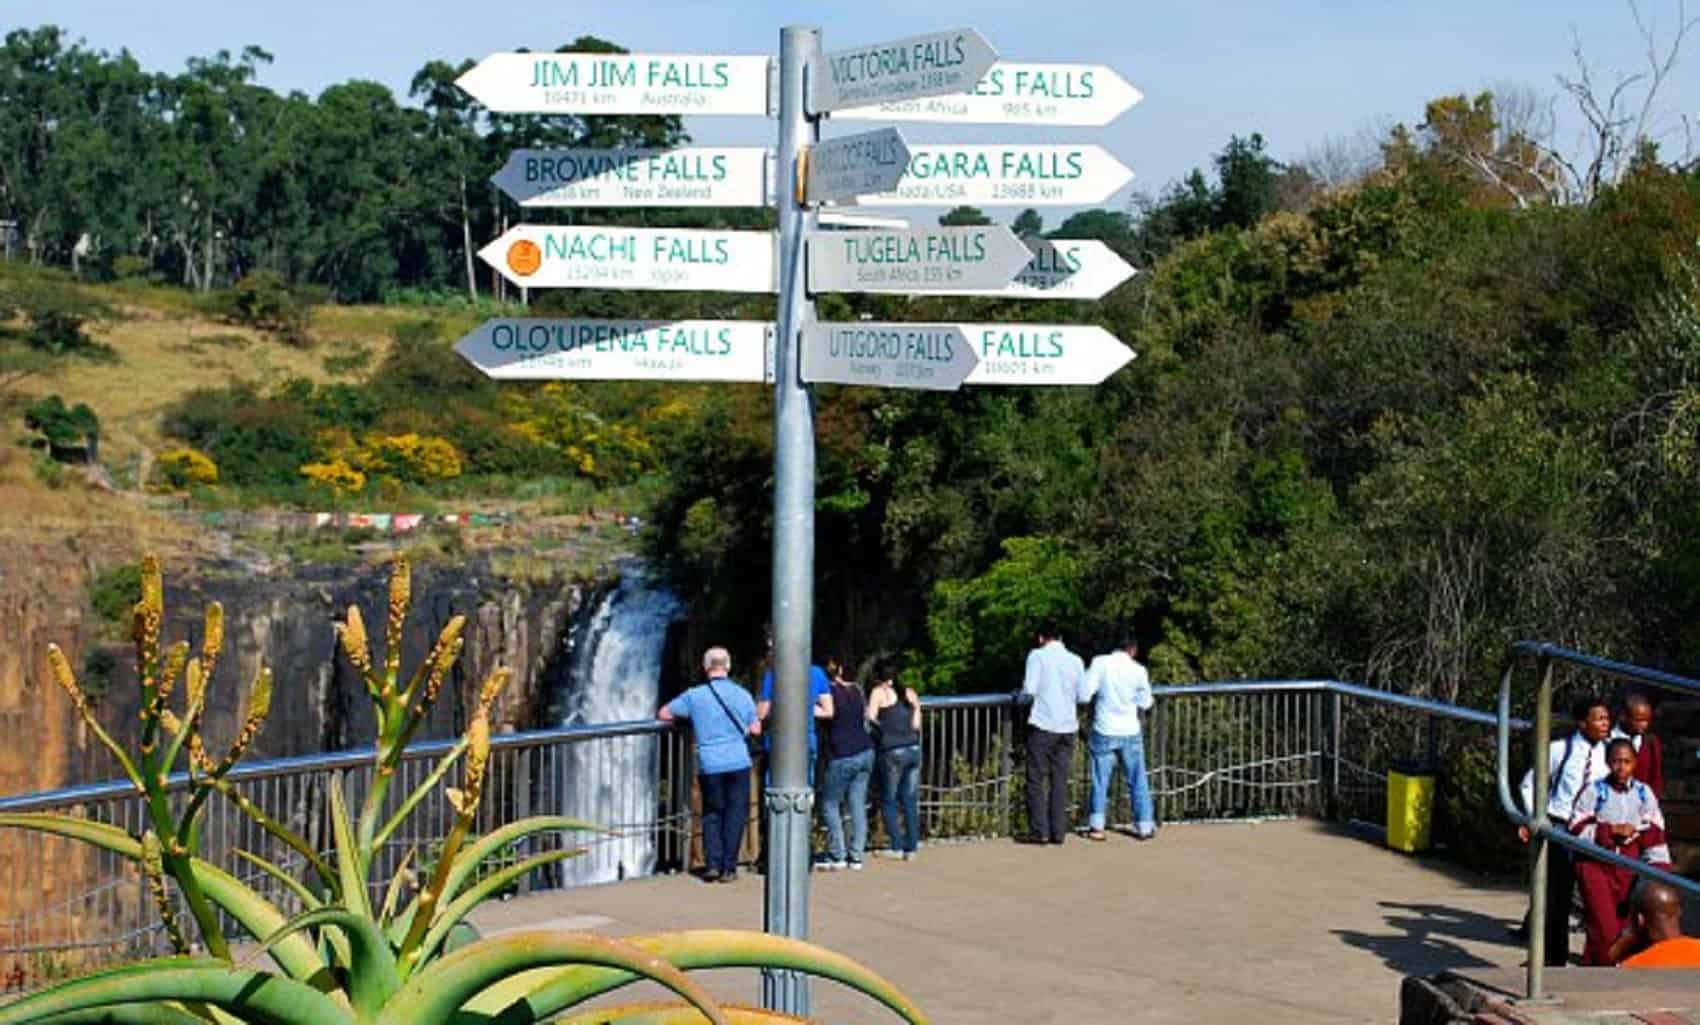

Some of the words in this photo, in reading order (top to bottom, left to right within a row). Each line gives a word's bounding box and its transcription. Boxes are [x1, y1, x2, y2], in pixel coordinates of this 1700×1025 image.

[830, 46, 910, 83] VICTORIA
[912, 34, 966, 71] FALLS
[529, 60, 579, 88] JIM
[587, 60, 637, 88] JIM
[648, 61, 730, 89] FALLS
[1016, 71, 1095, 99] FALLS
[592, 91, 617, 105] km
[925, 100, 969, 115] Africa
[525, 155, 640, 183] BROWNE
[648, 154, 728, 182] FALLS
[901, 151, 991, 179] GARA
[1001, 151, 1083, 179] FALLS
[622, 186, 650, 200] New
[657, 186, 712, 200] Zealand
[545, 232, 636, 263] NACHI
[654, 236, 729, 264] FALLS
[844, 235, 921, 264] TUGELA
[927, 232, 987, 263] FALLS
[1028, 247, 1083, 275] LLS
[491, 324, 649, 353] OLO'UPENA
[656, 328, 732, 356] FALLS
[906, 331, 954, 362] FALLS
[982, 331, 1064, 358] FALLS
